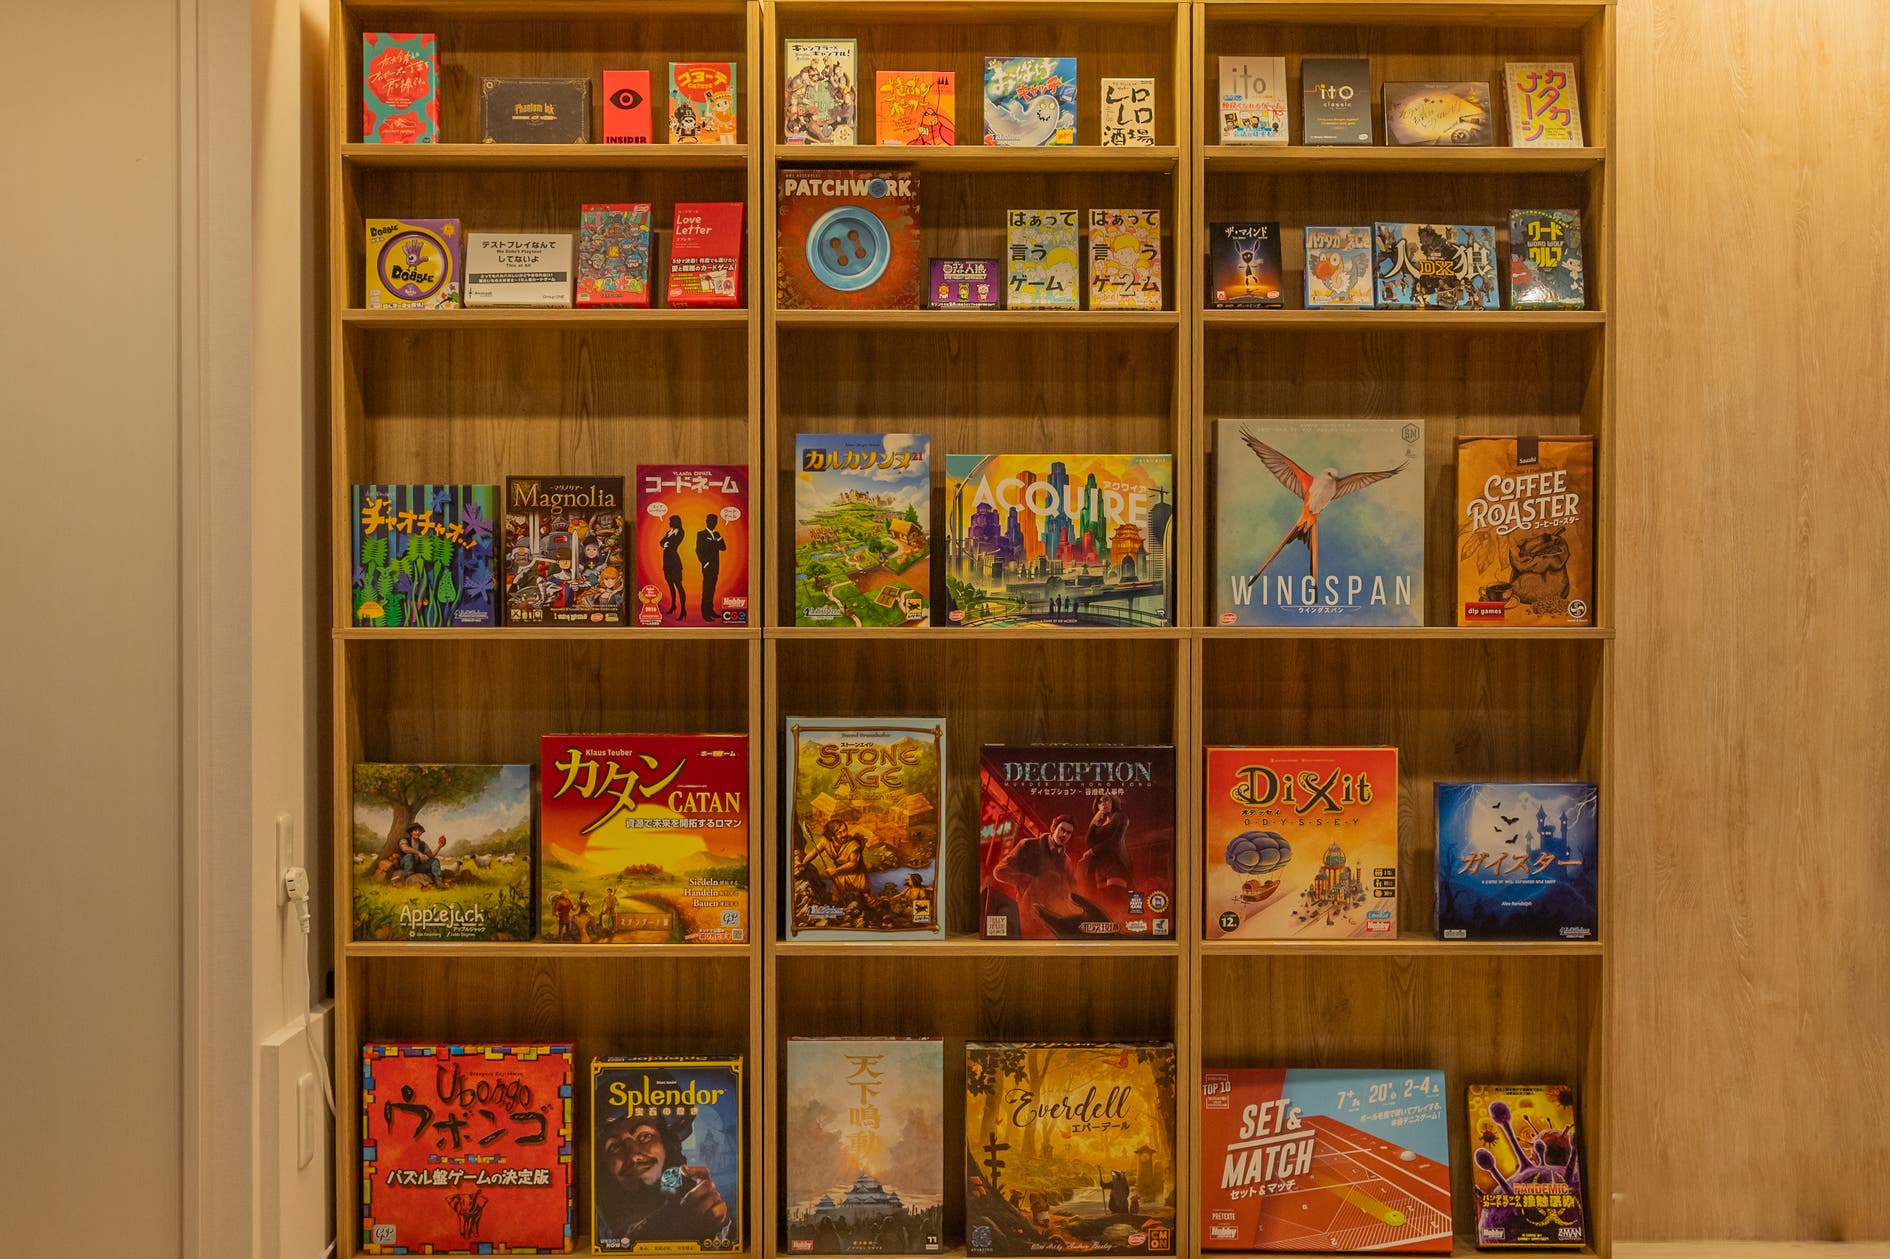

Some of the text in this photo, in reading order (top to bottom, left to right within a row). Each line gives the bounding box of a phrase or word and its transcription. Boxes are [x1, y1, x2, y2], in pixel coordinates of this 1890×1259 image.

[677, 71, 728, 88] コヨーテ
[1015, 75, 1062, 102] キャッチ
[1231, 64, 1267, 99] ito
[1320, 84, 1355, 100] ito
[514, 103, 543, 114] Phantom
[606, 136, 647, 144] INSIDER
[1103, 126, 1155, 147] 酒場
[676, 214, 702, 225] Love
[1009, 211, 1076, 227] はぁって
[1091, 210, 1157, 227] はぁって
[675, 225, 713, 240] Letter
[1225, 226, 1268, 239] ザ・マインド
[1527, 220, 1564, 241] ワード
[482, 241, 557, 250] テストプレイなんて
[1009, 243, 1047, 261] 言う
[498, 255, 540, 263] してないよ
[1384, 239, 1494, 281] 人 DX 狼
[1529, 247, 1563, 268] ウルフ
[1009, 275, 1065, 292] ゲーム
[1092, 275, 1159, 293] ゲーム
[804, 450, 924, 471] カルカソンヌ 21
[645, 476, 740, 494] コードネーム
[1483, 470, 1568, 502] COFFEE
[513, 484, 617, 515] Magnolia
[972, 474, 1148, 528] ACQUIRE
[1466, 493, 1581, 536] ROASTER
[1534, 517, 1581, 530] コーヒーロースター
[1231, 575, 1412, 606] WINGSPAN
[723, 597, 746, 607] Hobby
[1480, 608, 1503, 617] games
[607, 749, 633, 757] Teuber
[816, 744, 920, 770] STONE
[833, 766, 904, 791] AGE
[1004, 761, 1153, 782] DECEPTION
[552, 747, 686, 835] カタン
[1030, 788, 1077, 796] ディセプション
[667, 790, 741, 814] CATAN
[1241, 808, 1281, 816] オデッセイ
[625, 818, 742, 829] 資源で未来を開拓するロマン
[1457, 851, 1583, 876] ガイスター
[689, 877, 719, 886] Siedeln
[684, 888, 719, 897] Handeln
[693, 898, 719, 907] Bauen
[400, 903, 485, 930] Applejack
[436, 1062, 532, 1112] Ubongo
[1202, 1080, 1231, 1096] TOP 10
[1403, 1076, 1431, 1098] 2-4
[608, 1074, 725, 1119] Splendor
[844, 1053, 885, 1155] 天下鳴動
[1004, 1085, 1132, 1128] Everdell
[384, 1085, 554, 1150] ウボンゴ
[1239, 1098, 1303, 1140] SET &
[1221, 1138, 1315, 1190] MATCH
[386, 1169, 551, 1186] パズル盤ゲームの決定版
[1513, 1183, 1570, 1195] PANDEMIC
[1522, 1195, 1576, 1209] 接触感染
